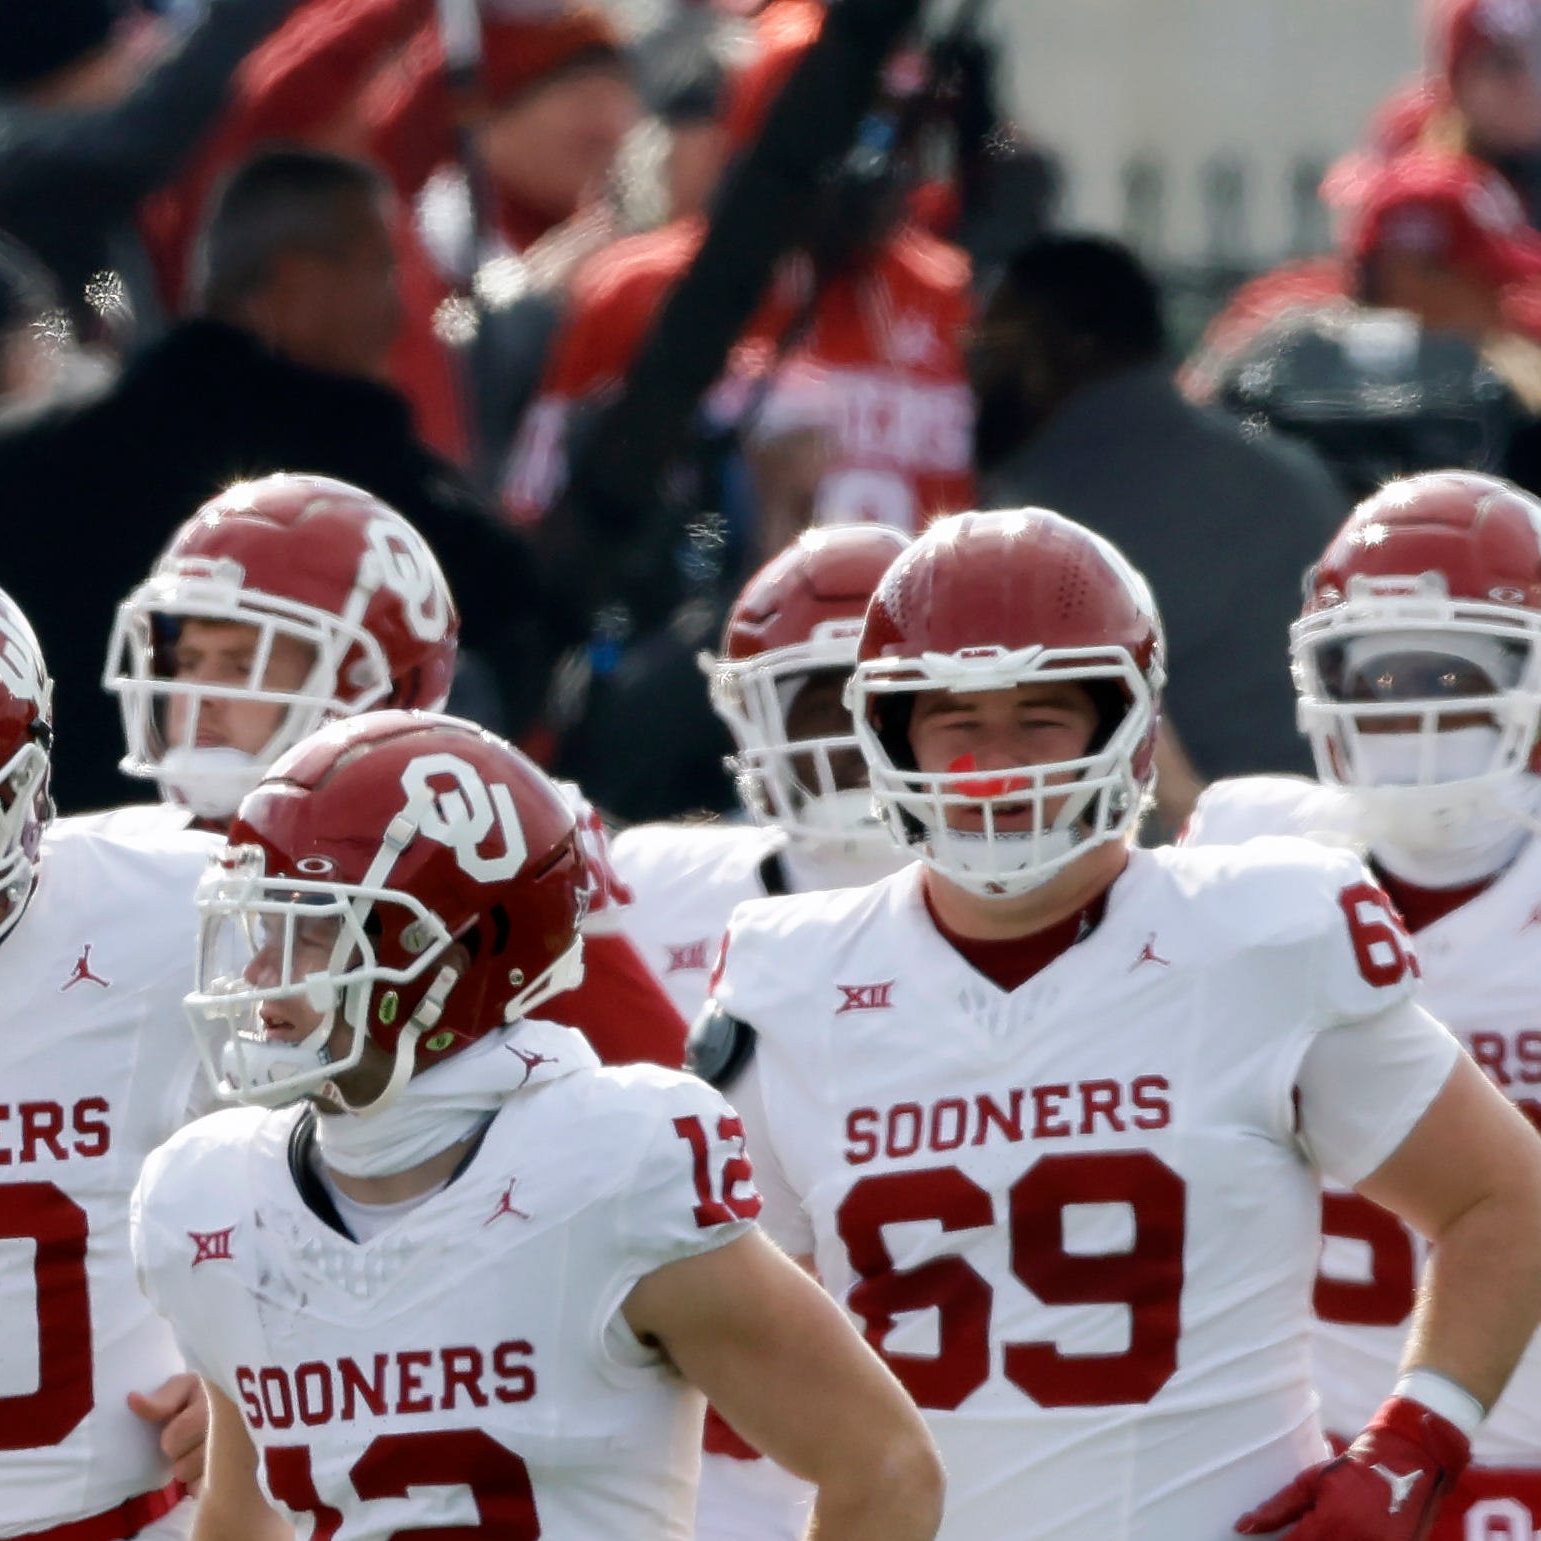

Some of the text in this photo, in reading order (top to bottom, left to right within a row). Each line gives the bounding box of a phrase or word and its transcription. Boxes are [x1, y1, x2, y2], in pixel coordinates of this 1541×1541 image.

[369, 517, 450, 643] OU
[401, 752, 527, 883] OU
[834, 978, 895, 1016] XII
[672, 1114, 763, 1228] 12
[844, 1074, 1171, 1166] SOONERS
[187, 1225, 236, 1268] XII
[835, 1148, 1188, 1412] 69
[235, 1339, 538, 1430] SOONERS
